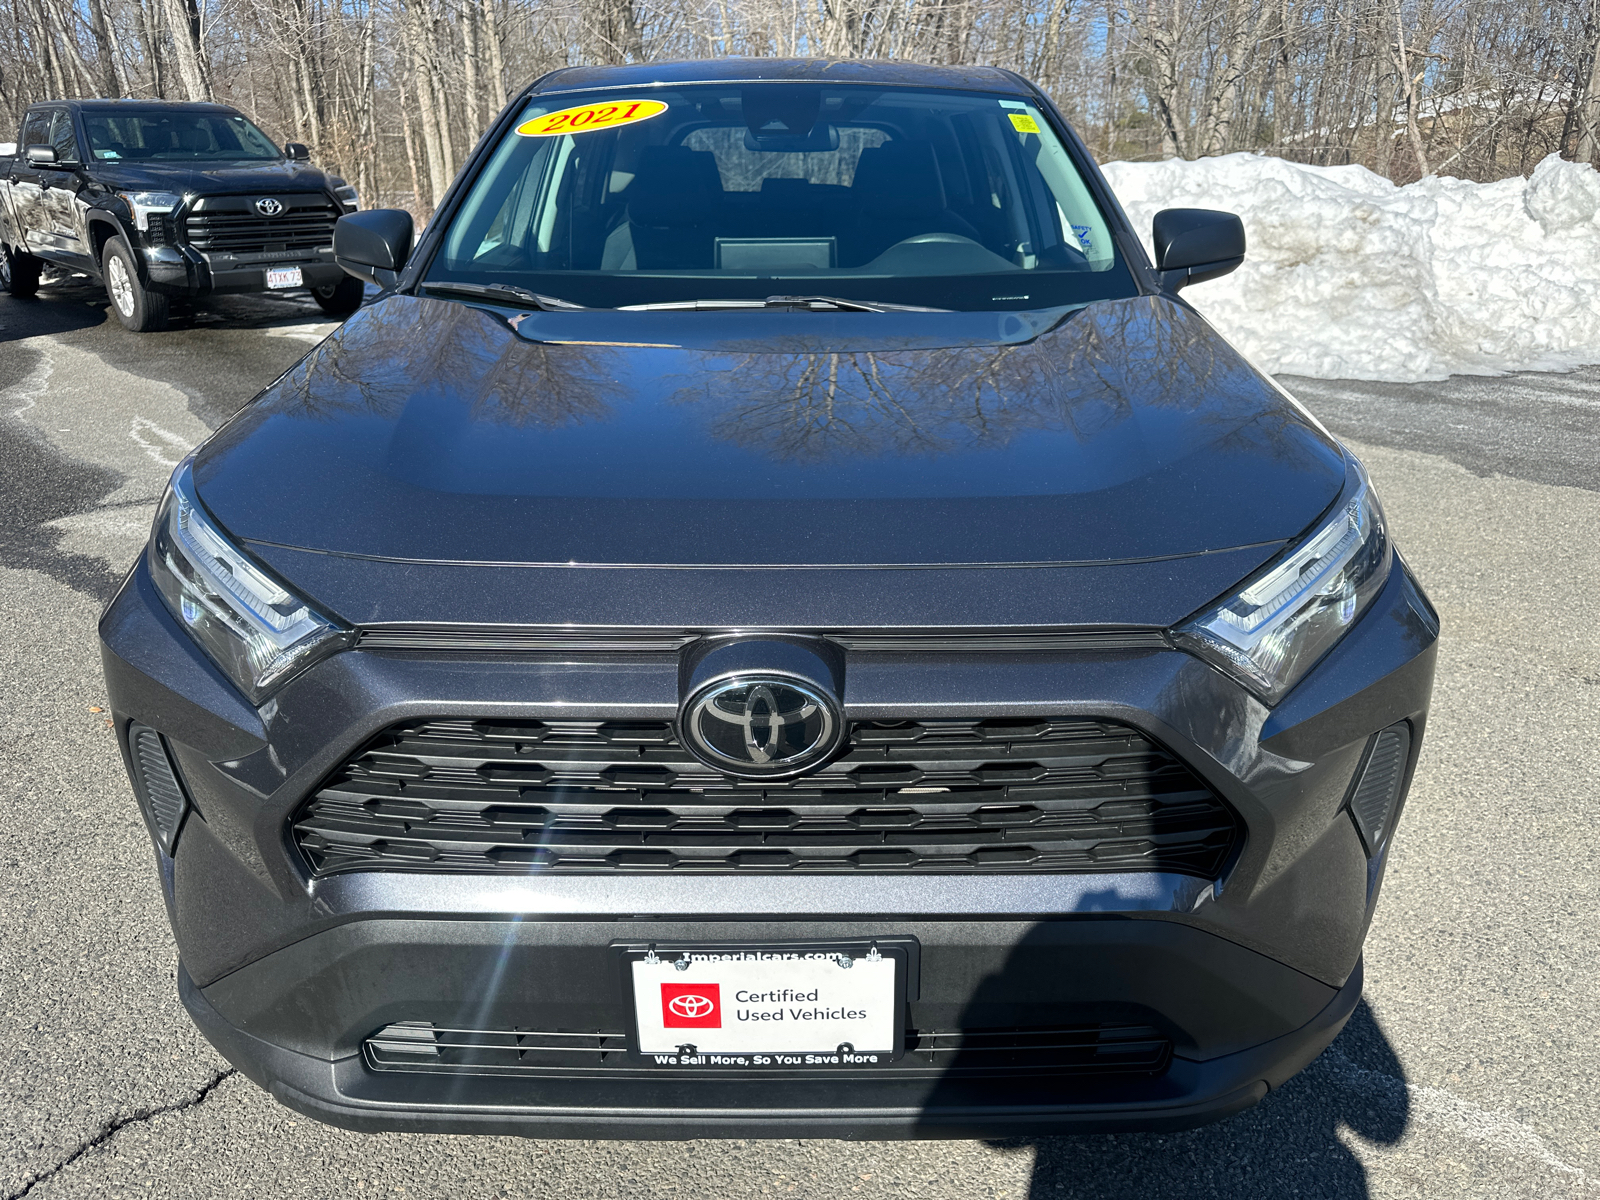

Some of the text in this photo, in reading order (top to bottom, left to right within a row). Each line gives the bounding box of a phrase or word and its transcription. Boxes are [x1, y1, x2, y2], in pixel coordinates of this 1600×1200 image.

[541, 102, 642, 133] 2021
[290, 271, 302, 281] 73
[682, 952, 842, 963] Imperialcars.com
[735, 988, 818, 1003] Certified
[737, 1006, 867, 1021] Used Vehicles
[654, 1053, 878, 1066] We Sell More, So You Save More
